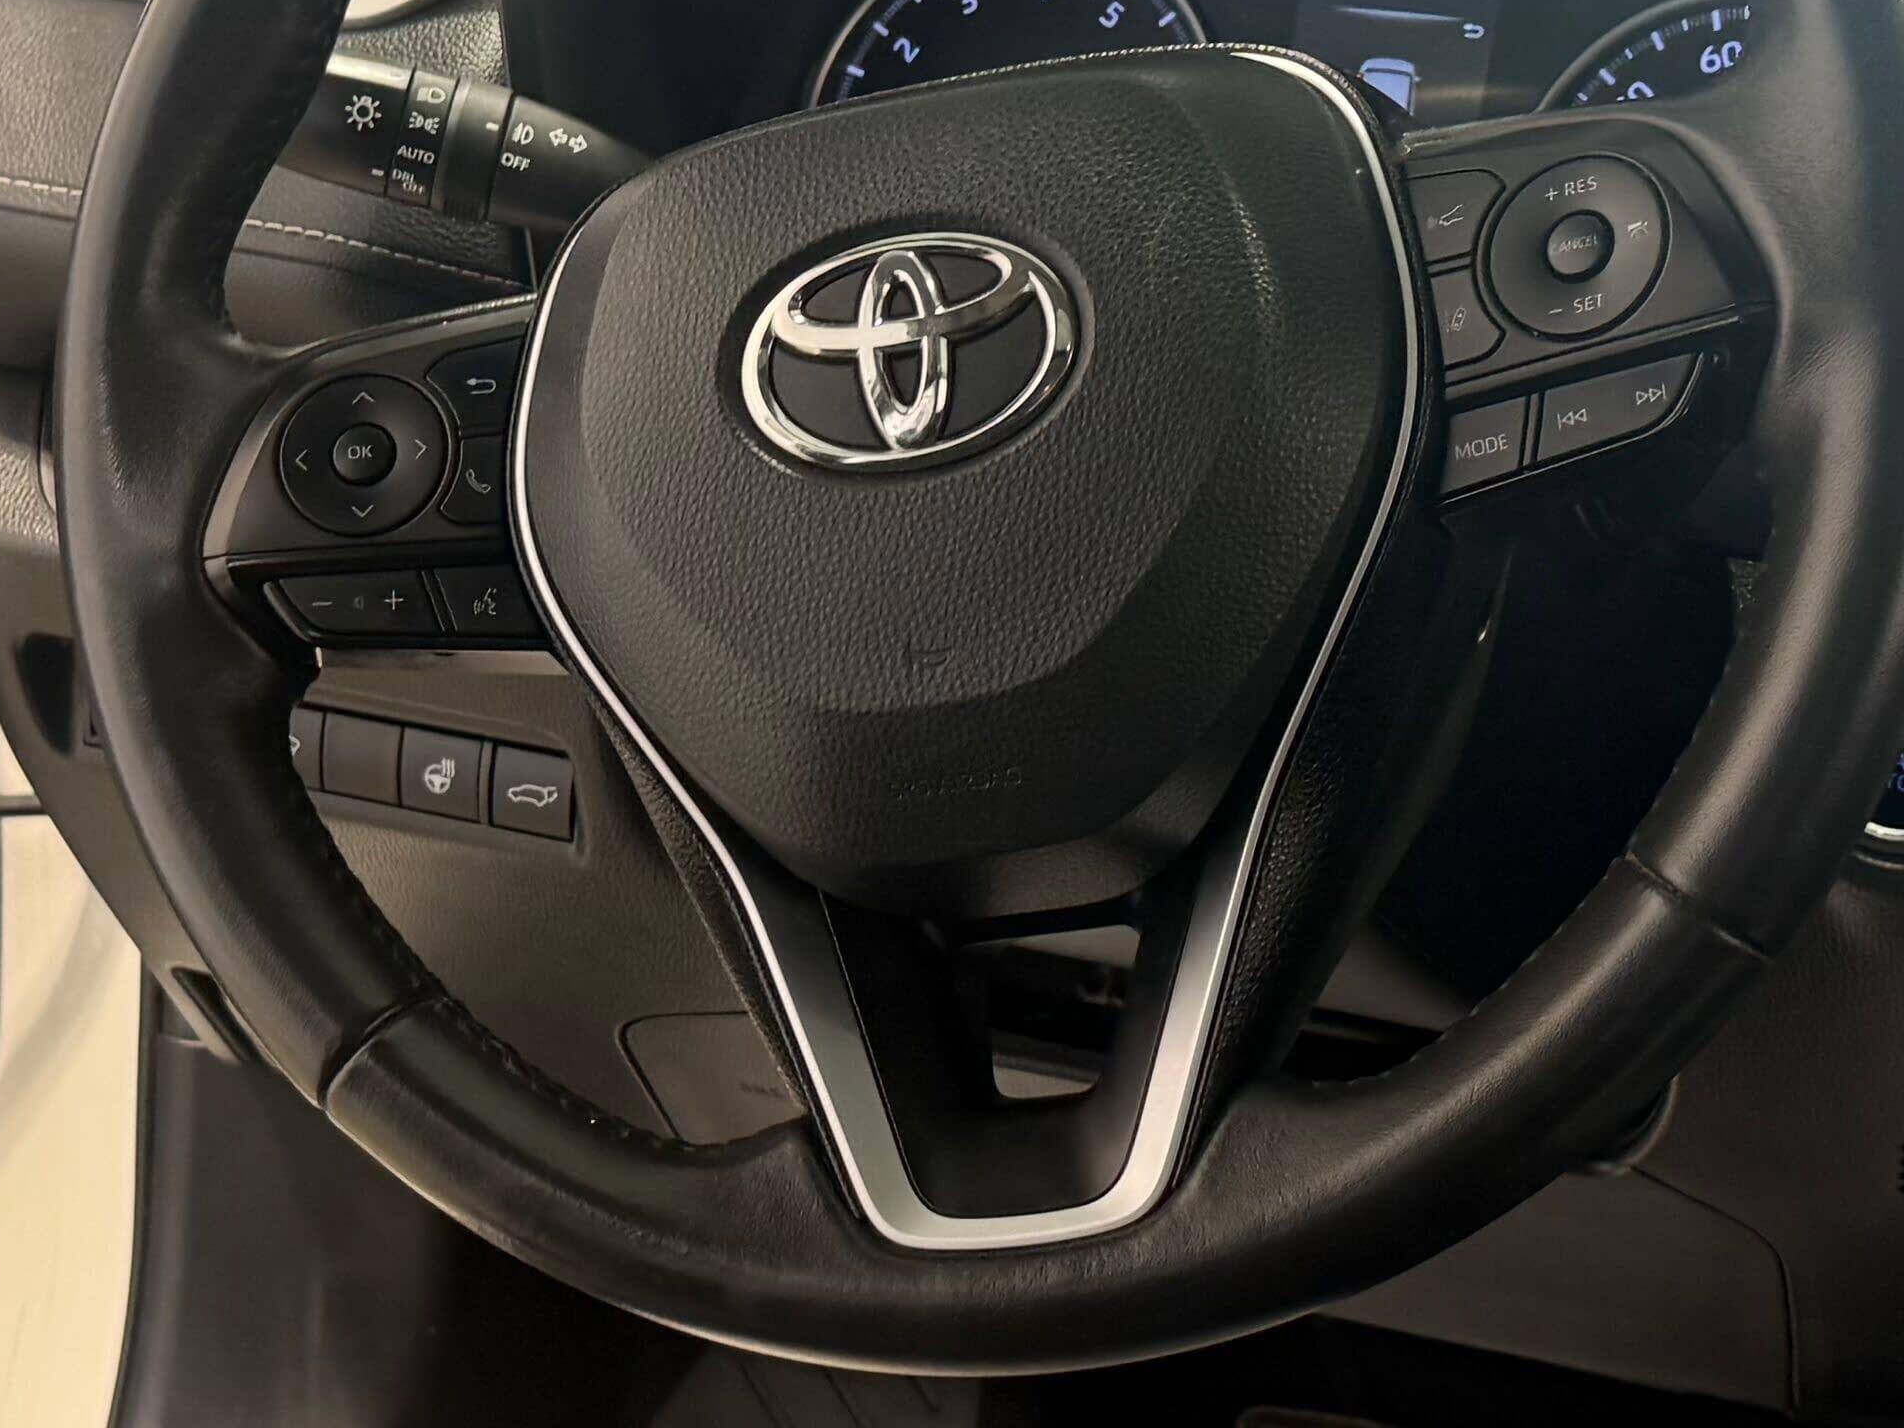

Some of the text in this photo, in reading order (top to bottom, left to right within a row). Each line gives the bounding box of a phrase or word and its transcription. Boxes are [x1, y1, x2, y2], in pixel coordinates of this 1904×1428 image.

[1098, 1, 1125, 29] 5
[893, 37, 920, 64] 2
[397, 145, 435, 164] AUTO
[501, 152, 530, 171] OFF
[1564, 176, 1597, 196] RES
[1573, 293, 1602, 313] SET
[347, 444, 373, 460] OK
[1455, 434, 1509, 461] MODE
